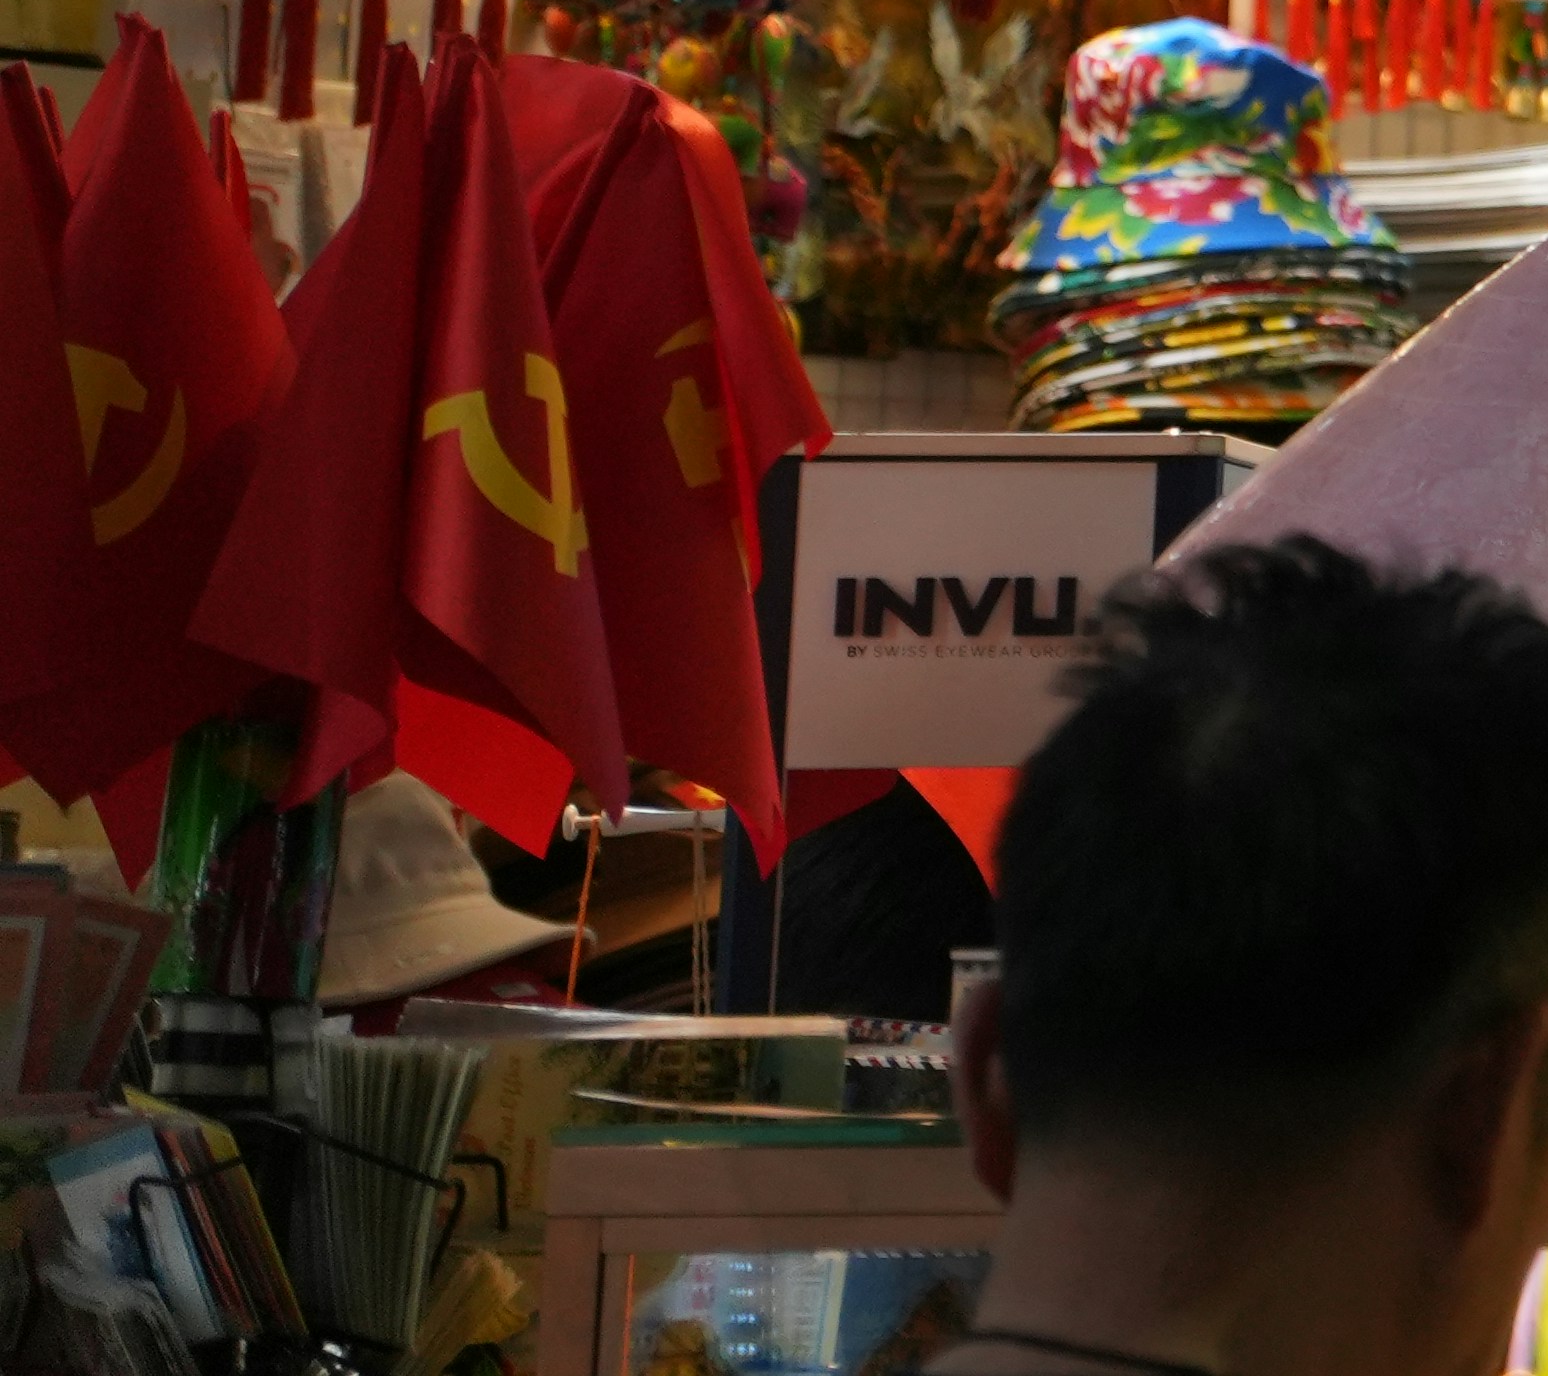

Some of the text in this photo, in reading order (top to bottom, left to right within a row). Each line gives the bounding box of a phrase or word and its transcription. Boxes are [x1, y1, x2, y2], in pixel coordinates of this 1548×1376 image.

[846, 645, 866, 659] BY
[873, 645, 928, 659] SWISS
[935, 646, 1023, 660] EYEWEAR
